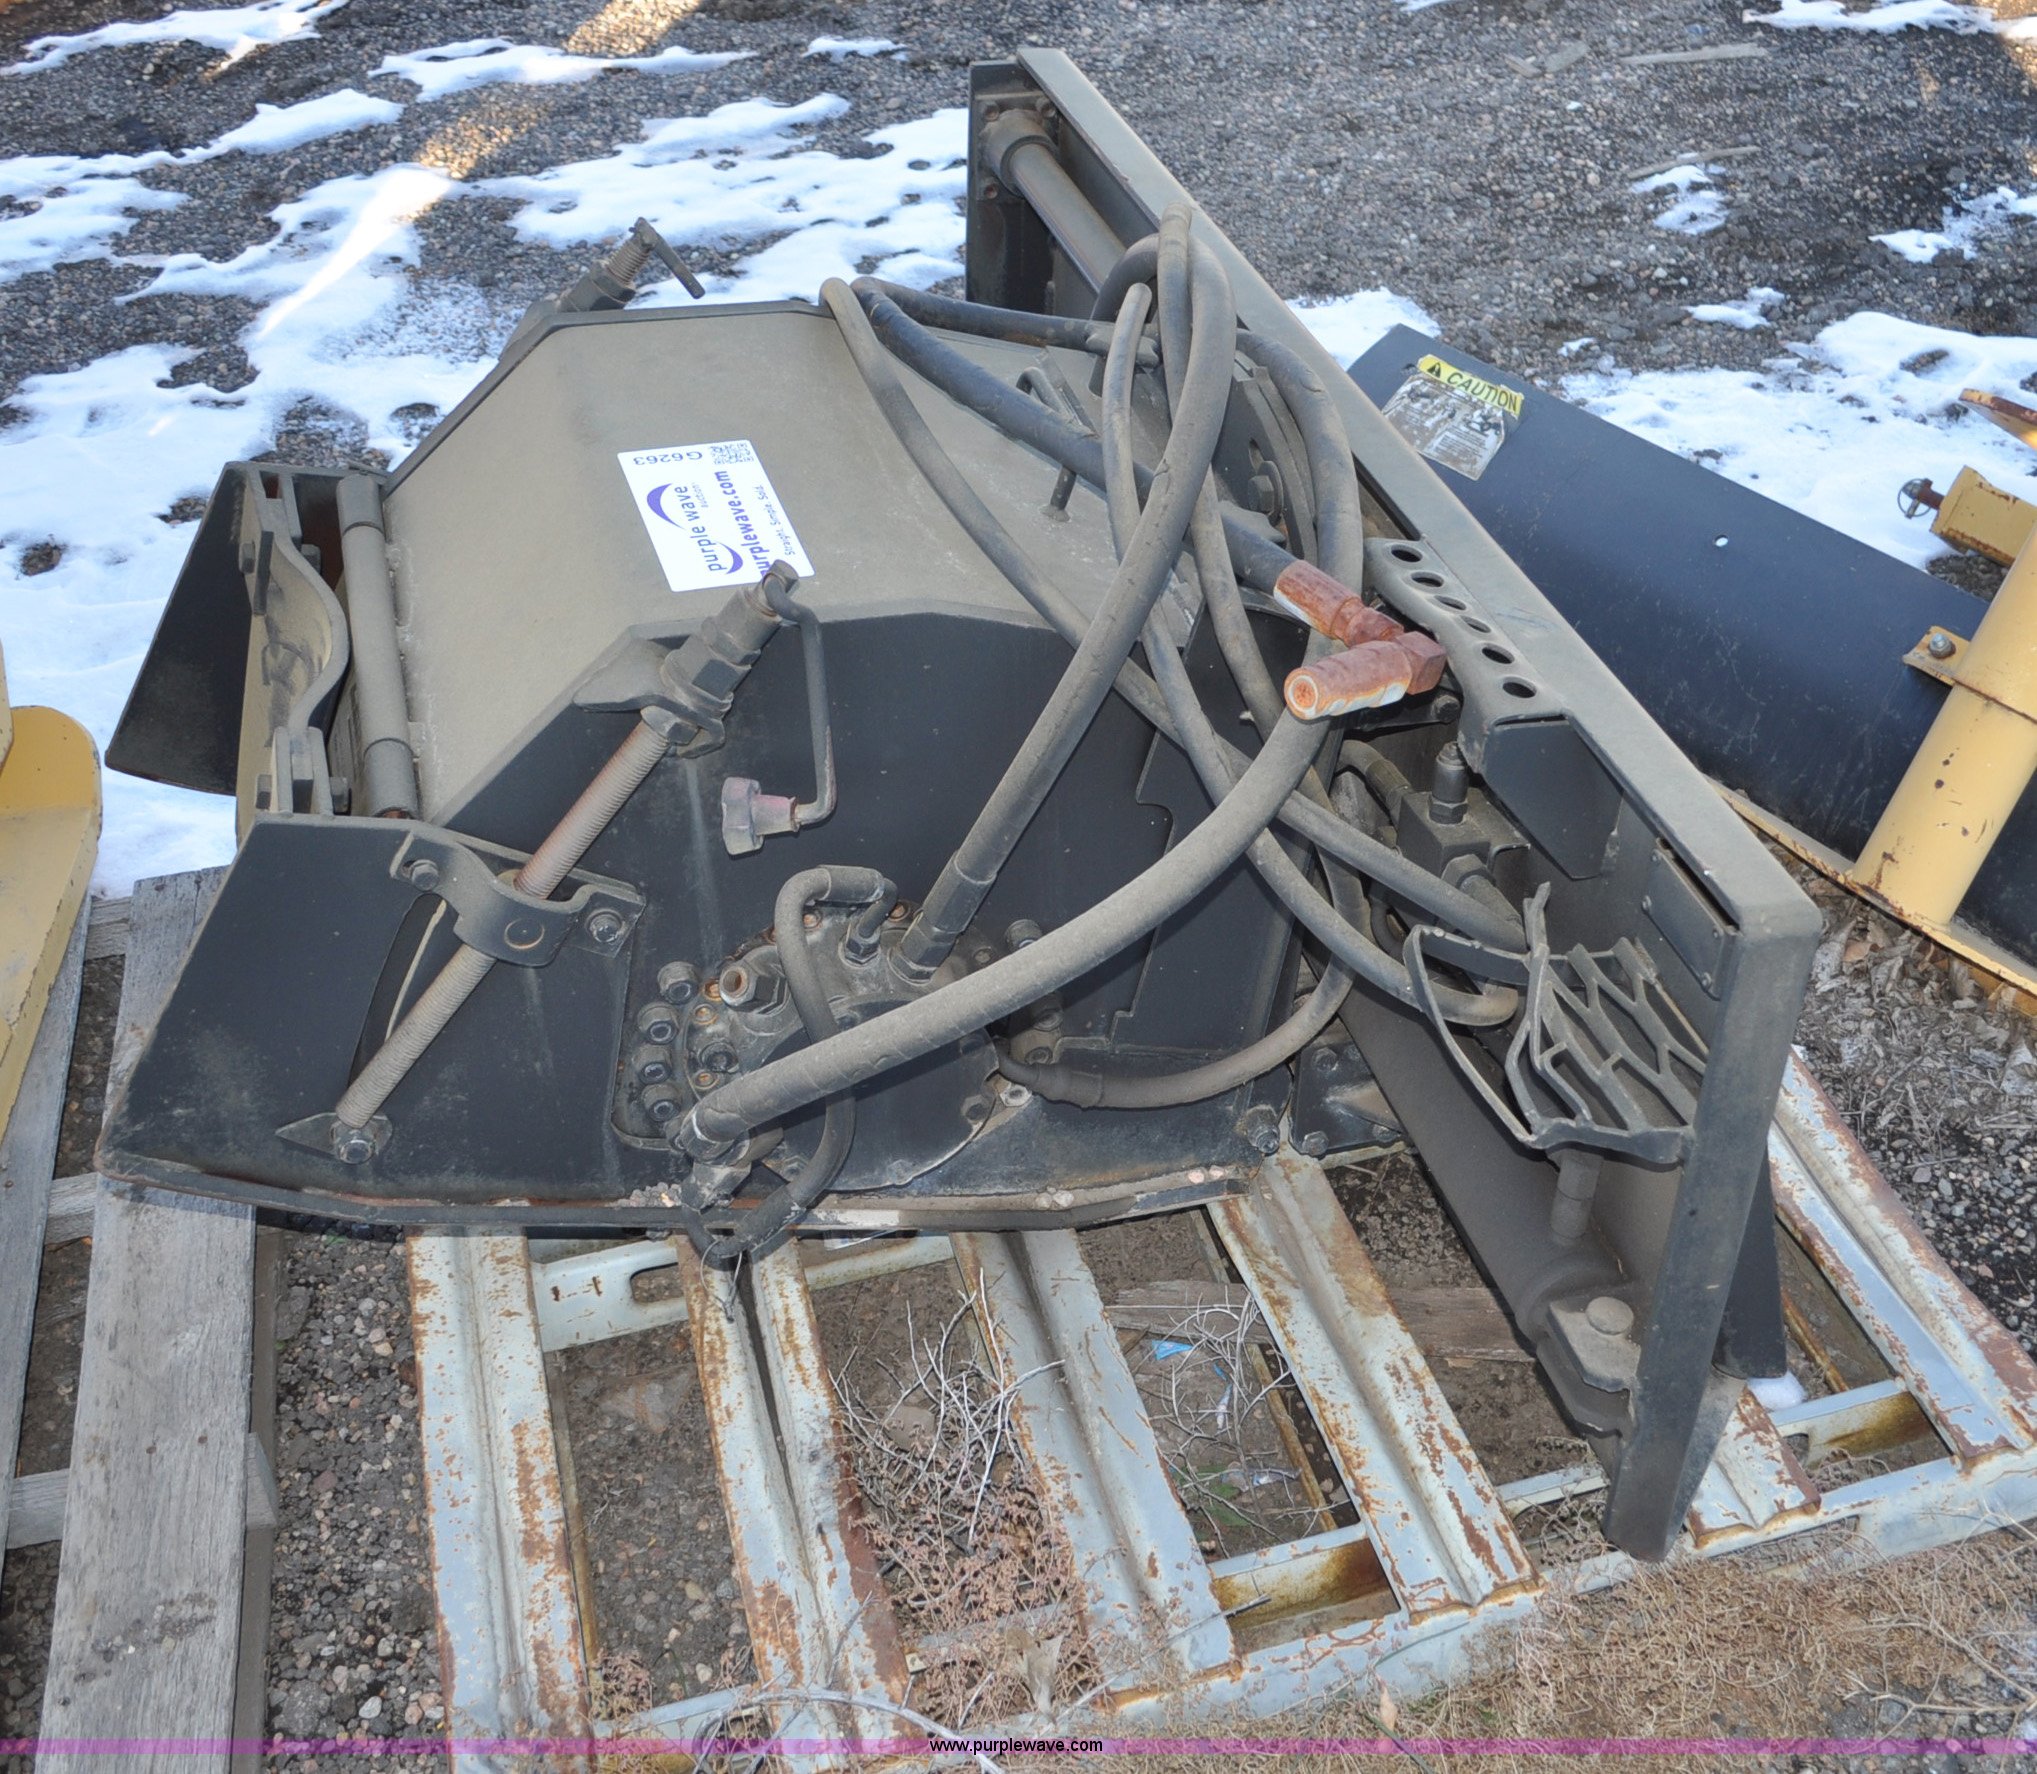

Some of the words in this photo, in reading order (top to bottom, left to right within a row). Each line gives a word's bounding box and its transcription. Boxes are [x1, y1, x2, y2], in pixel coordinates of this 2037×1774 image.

[1446, 372, 1517, 412] CAUTION
[633, 451, 703, 466] G6263
[674, 486, 701, 522] wave
[714, 470, 770, 577] urplewave.com
[690, 526, 727, 572] purple
